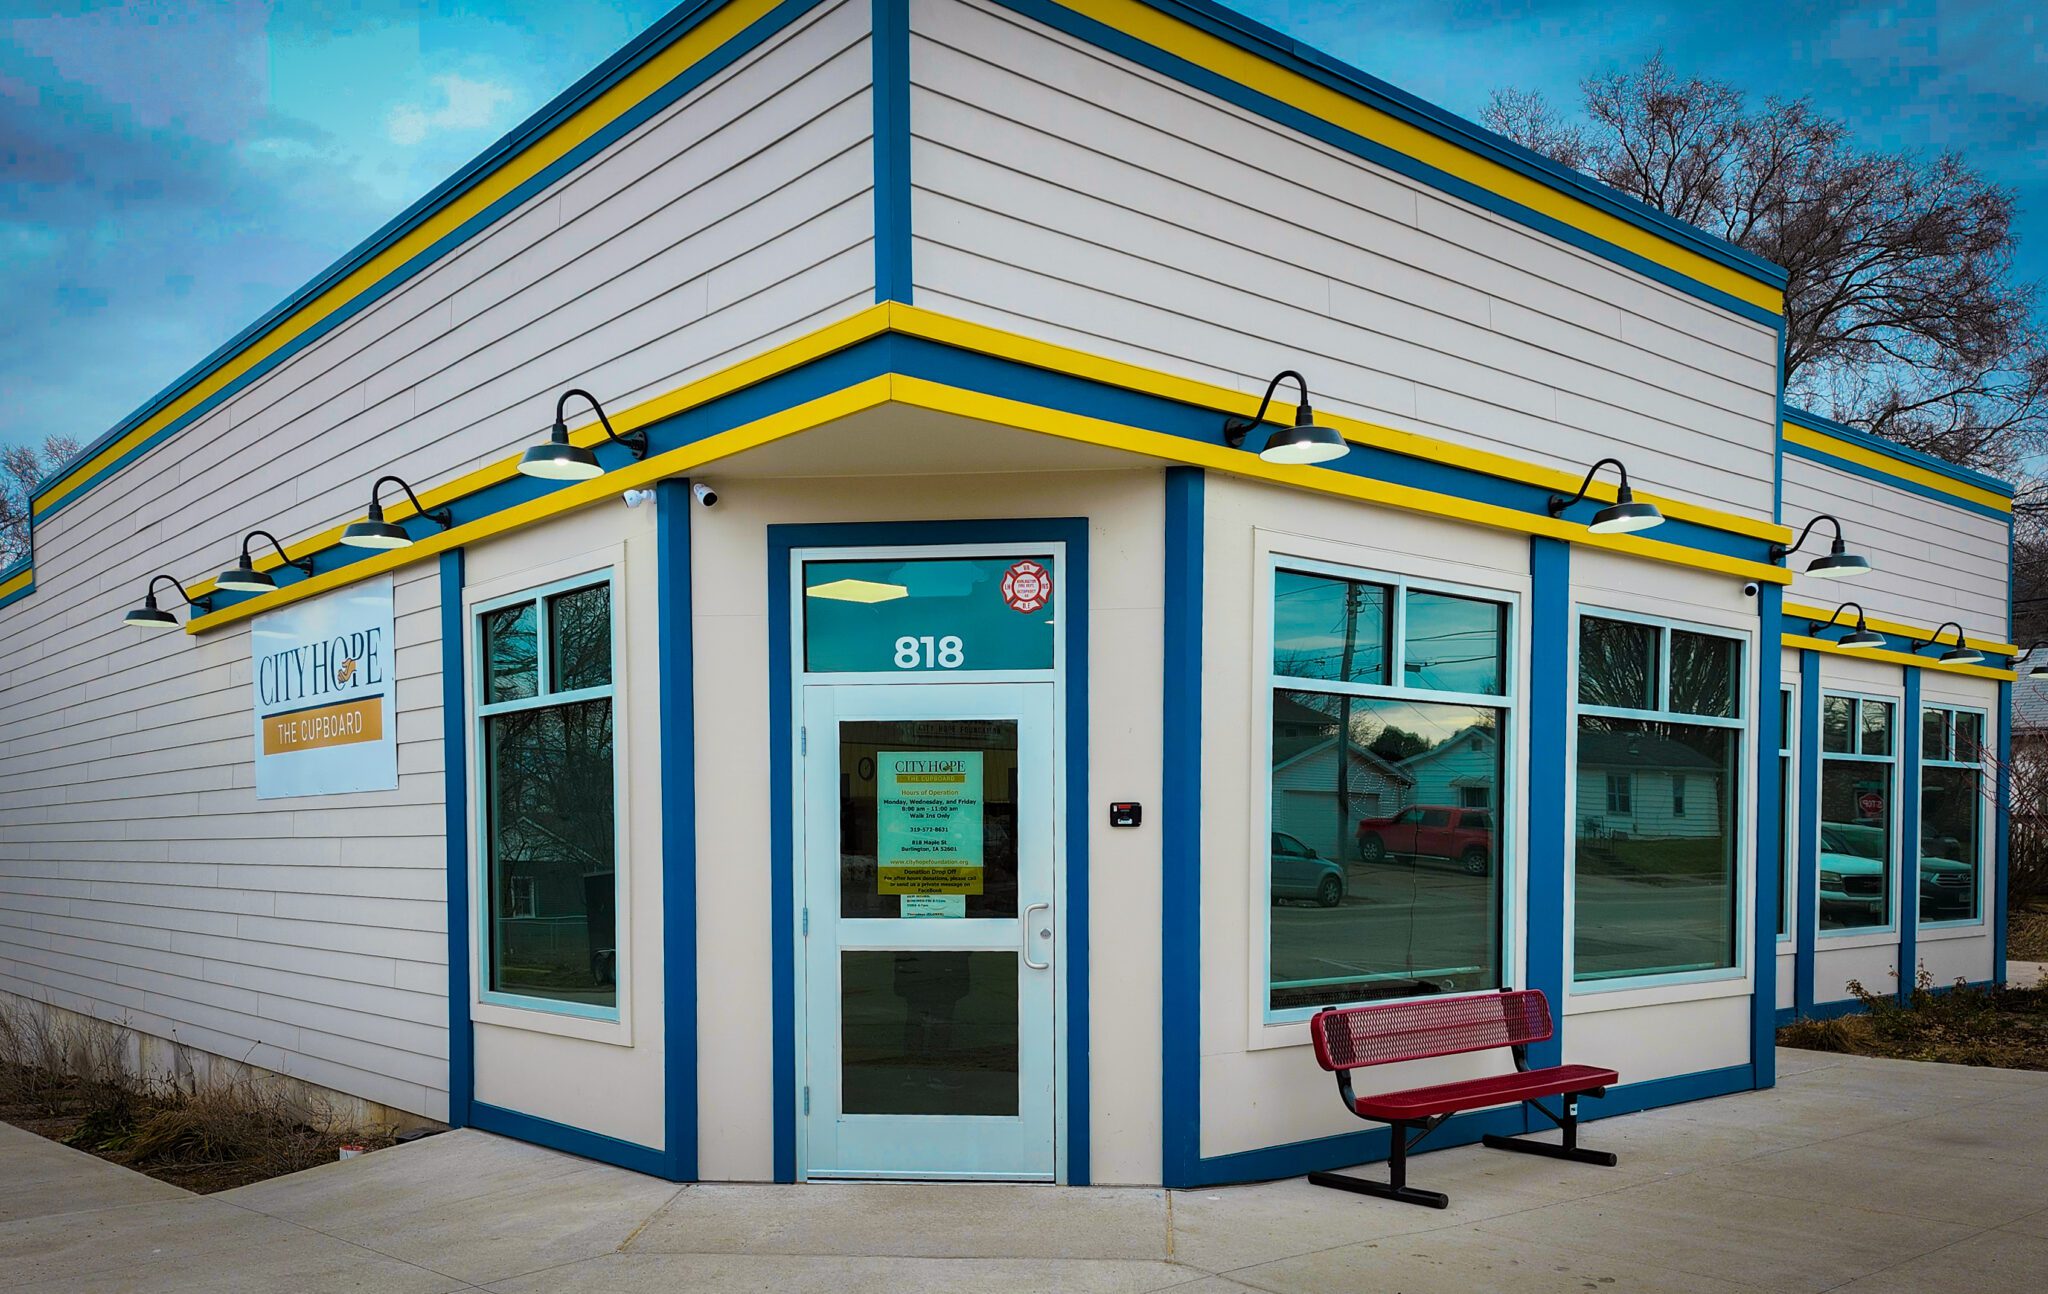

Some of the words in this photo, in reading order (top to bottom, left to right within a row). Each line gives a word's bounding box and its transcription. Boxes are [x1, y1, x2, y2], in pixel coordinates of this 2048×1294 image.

[260, 646, 308, 706] CITY
[312, 627, 383, 696] HOPE
[894, 635, 965, 669] 818
[278, 722, 297, 745] THE
[301, 711, 363, 742] CUPBOARD
[895, 761, 927, 773] CITY
[929, 761, 966, 773] HOPE
